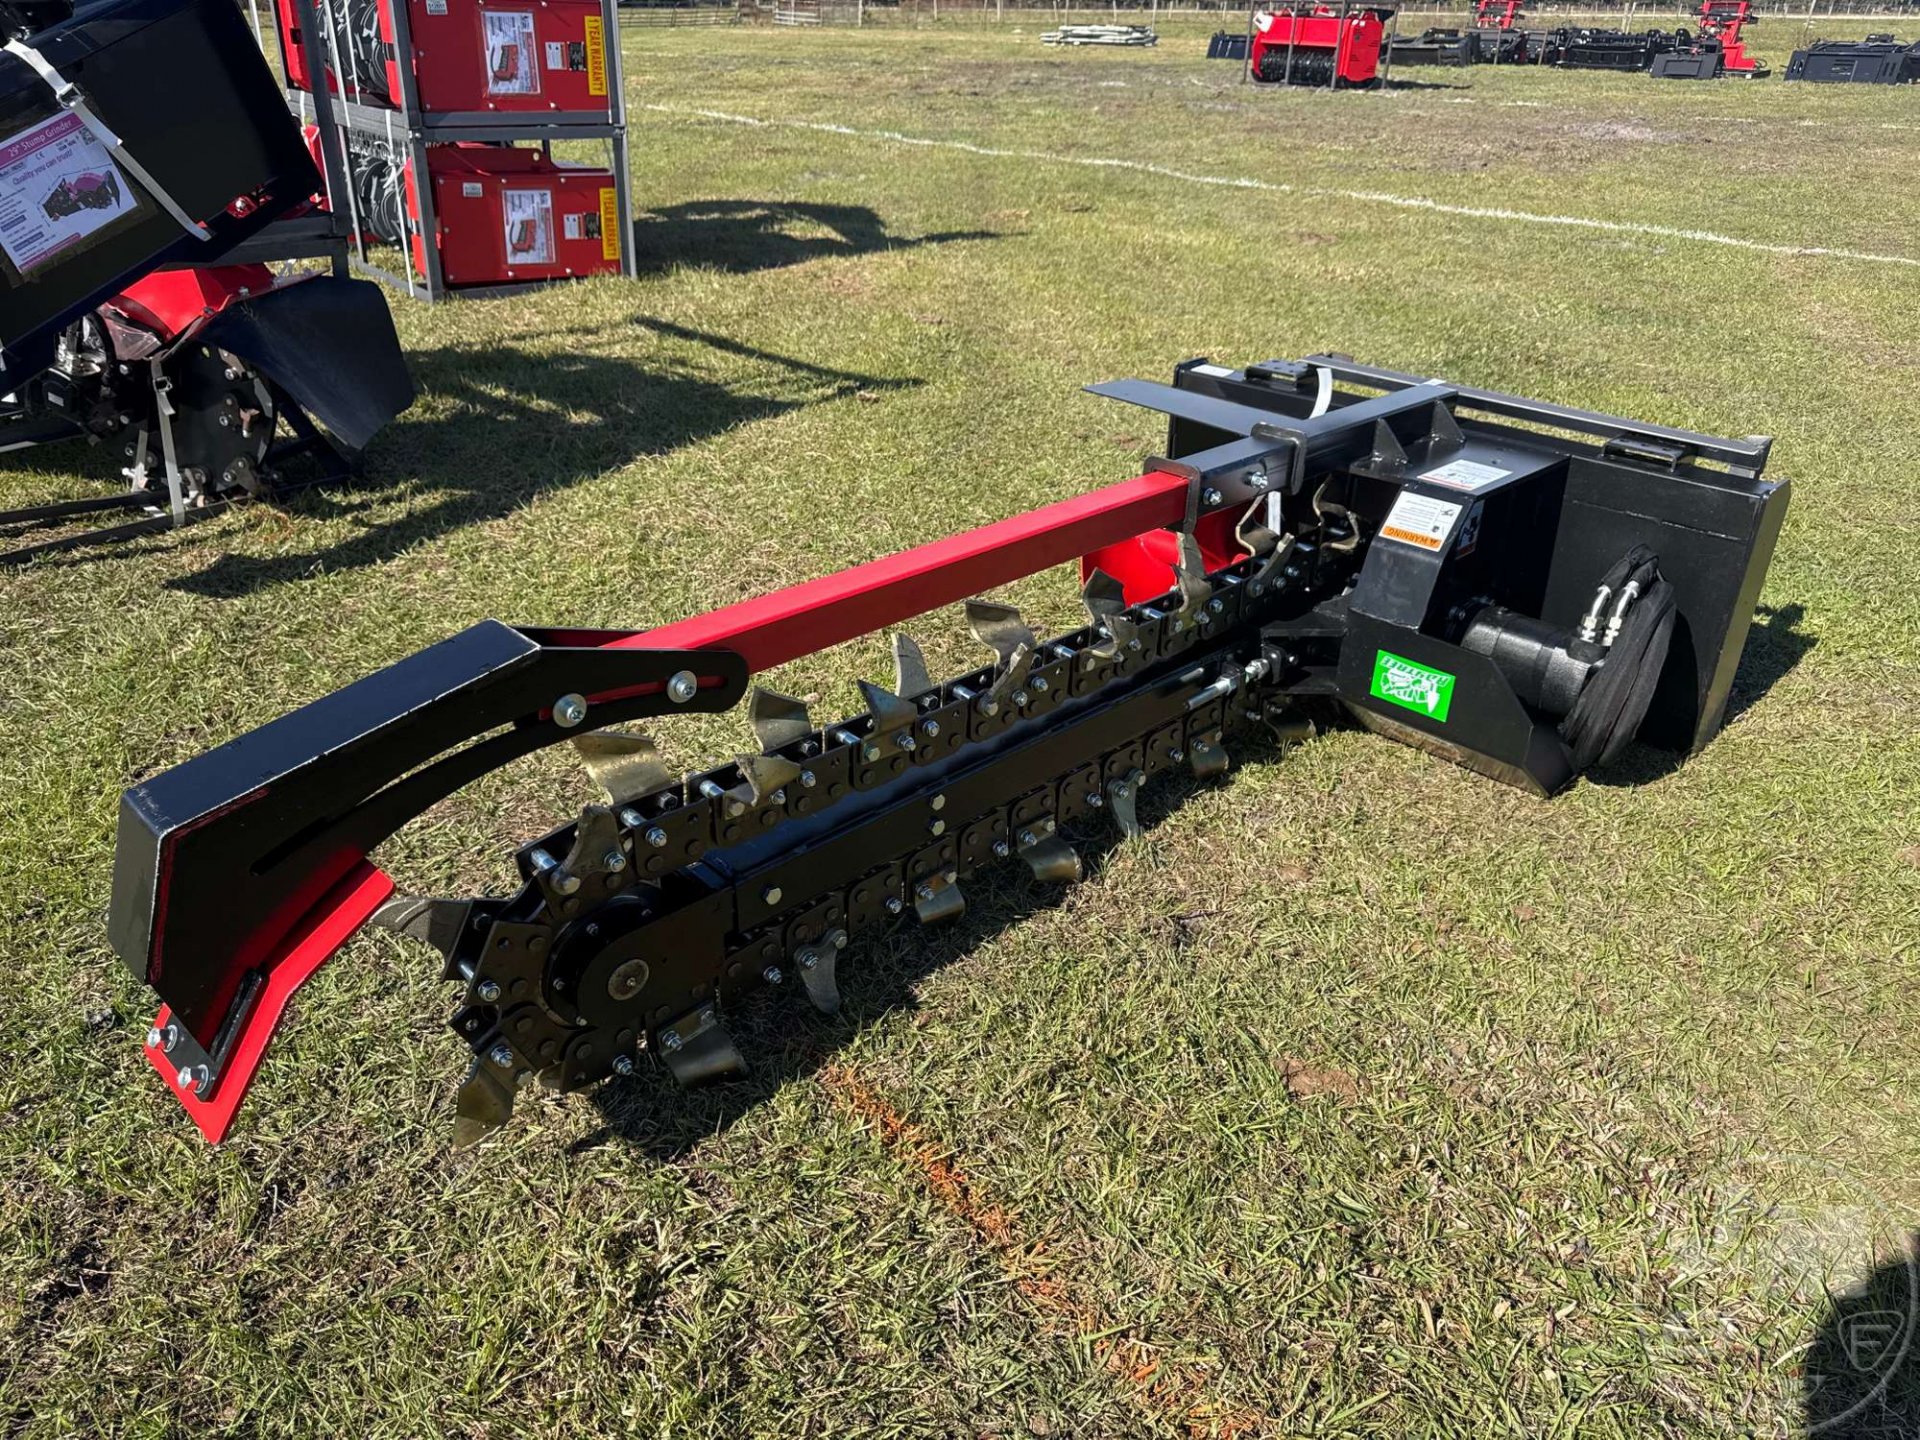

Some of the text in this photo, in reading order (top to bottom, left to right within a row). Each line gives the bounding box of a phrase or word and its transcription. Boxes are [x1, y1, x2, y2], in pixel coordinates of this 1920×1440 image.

[589, 25, 601, 46] YEAR
[590, 48, 604, 92] WARRANTY
[22, 134, 46, 152] Stump
[46, 119, 73, 138] Grinder
[12, 169, 35, 185] Quality
[35, 165, 47, 178] you
[46, 159, 57, 170] can
[1388, 527, 1428, 546] WARNING
